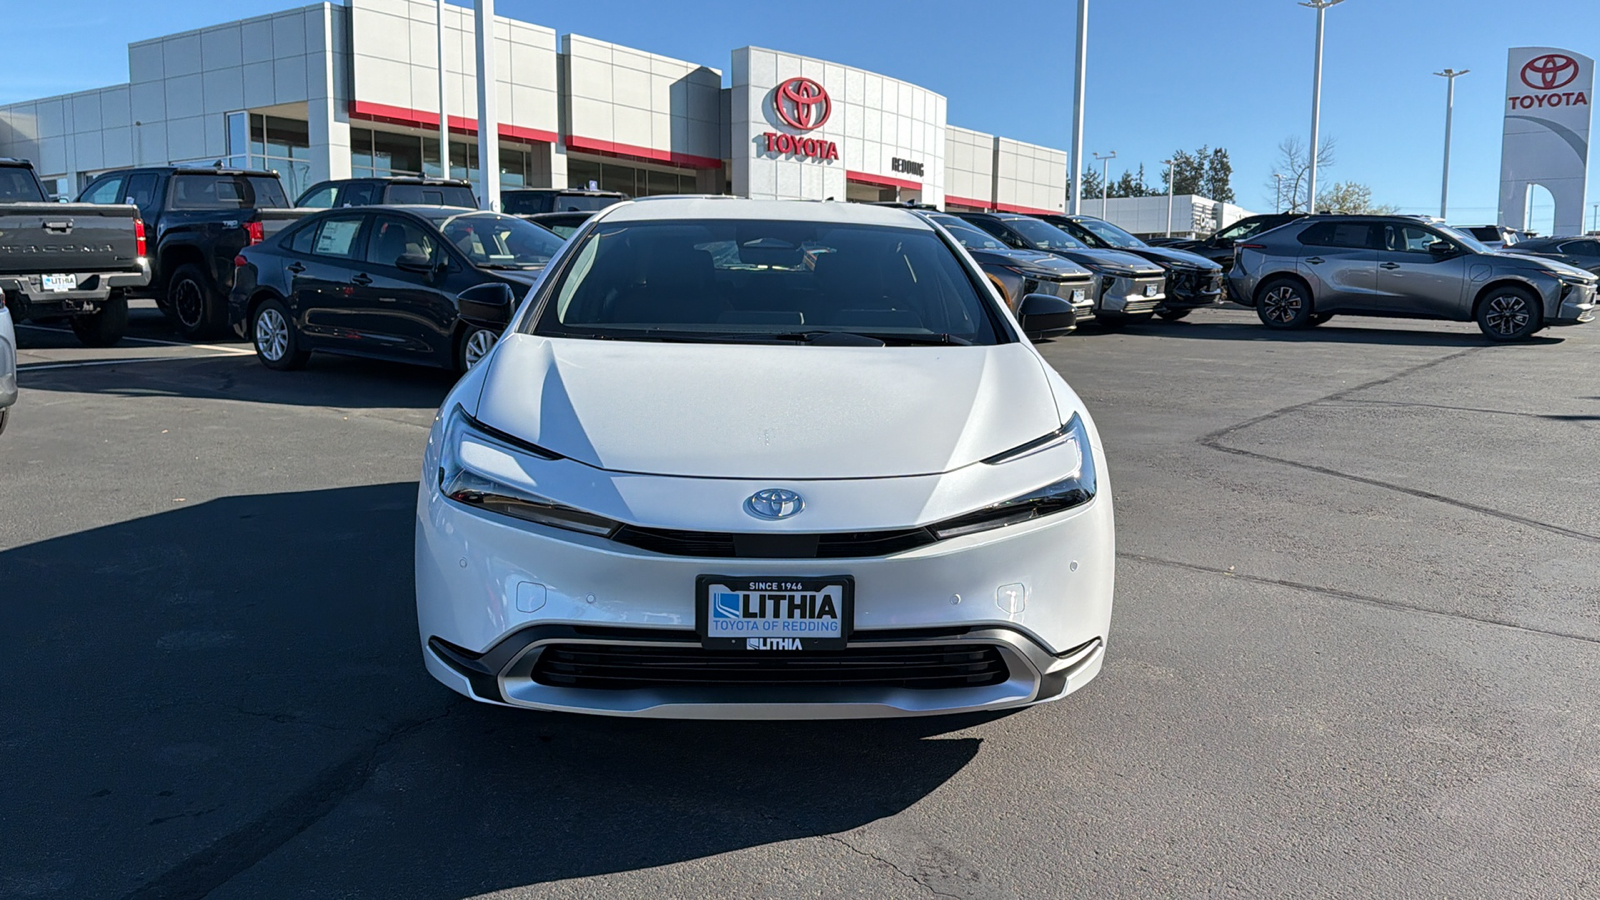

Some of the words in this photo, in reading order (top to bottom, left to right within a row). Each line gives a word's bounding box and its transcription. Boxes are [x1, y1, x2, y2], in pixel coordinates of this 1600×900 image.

[1508, 92, 1588, 110] TOYOTA
[763, 132, 839, 160] TOYOTA
[1, 244, 114, 254] TACOMA
[749, 582, 778, 590] SINCE
[781, 582, 803, 590] 1946
[742, 594, 838, 619] LITHIA
[713, 620, 759, 631] TOYOTA
[762, 620, 779, 631] OF
[782, 621, 838, 632] REDDING
[759, 638, 803, 651] LITHIA
